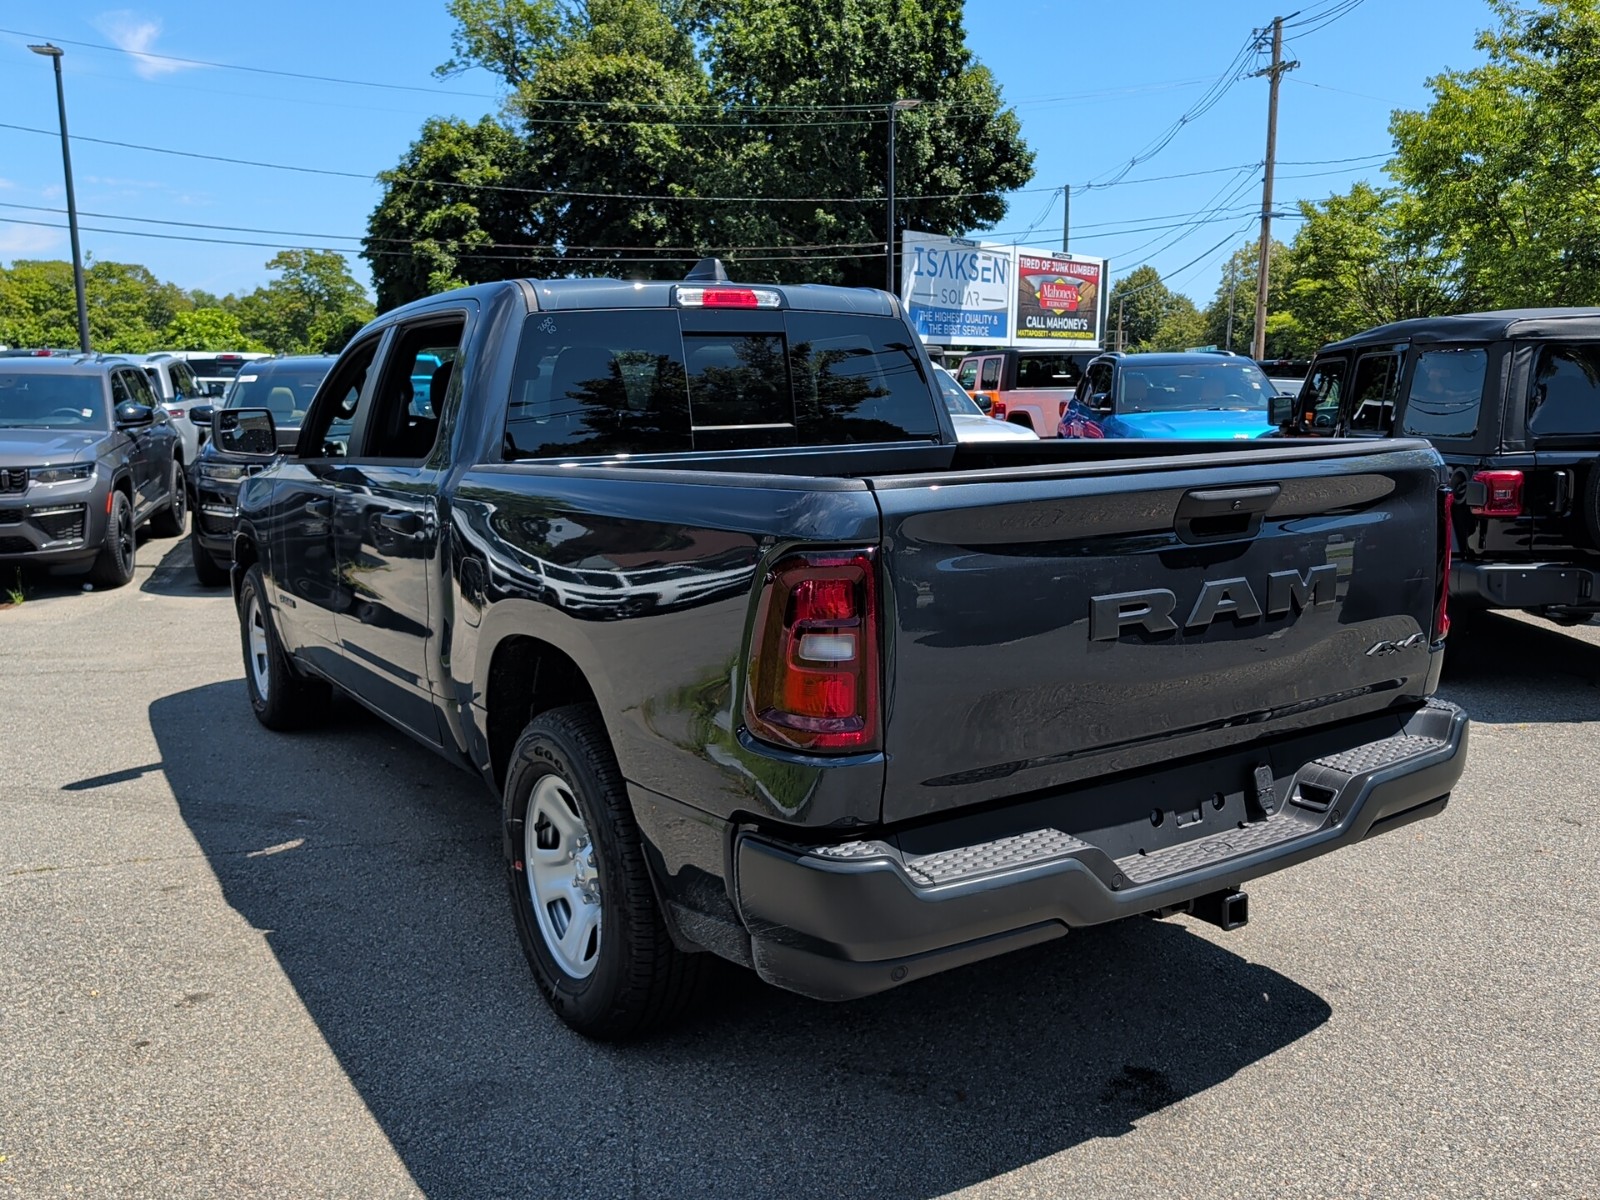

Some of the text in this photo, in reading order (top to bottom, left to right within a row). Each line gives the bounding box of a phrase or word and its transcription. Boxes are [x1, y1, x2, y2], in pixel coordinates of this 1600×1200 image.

[914, 246, 1006, 284] ISAKSEN
[1020, 257, 1098, 277] TIRED OF JUNK LUMBER?
[941, 288, 980, 307] SOLAR
[918, 310, 998, 326] THE HIGHEST QUALITY &
[1026, 315, 1088, 331] CALL MAHONEY'S
[928, 323, 990, 337] THE BEST SERVICE
[1090, 563, 1337, 642] RAM
